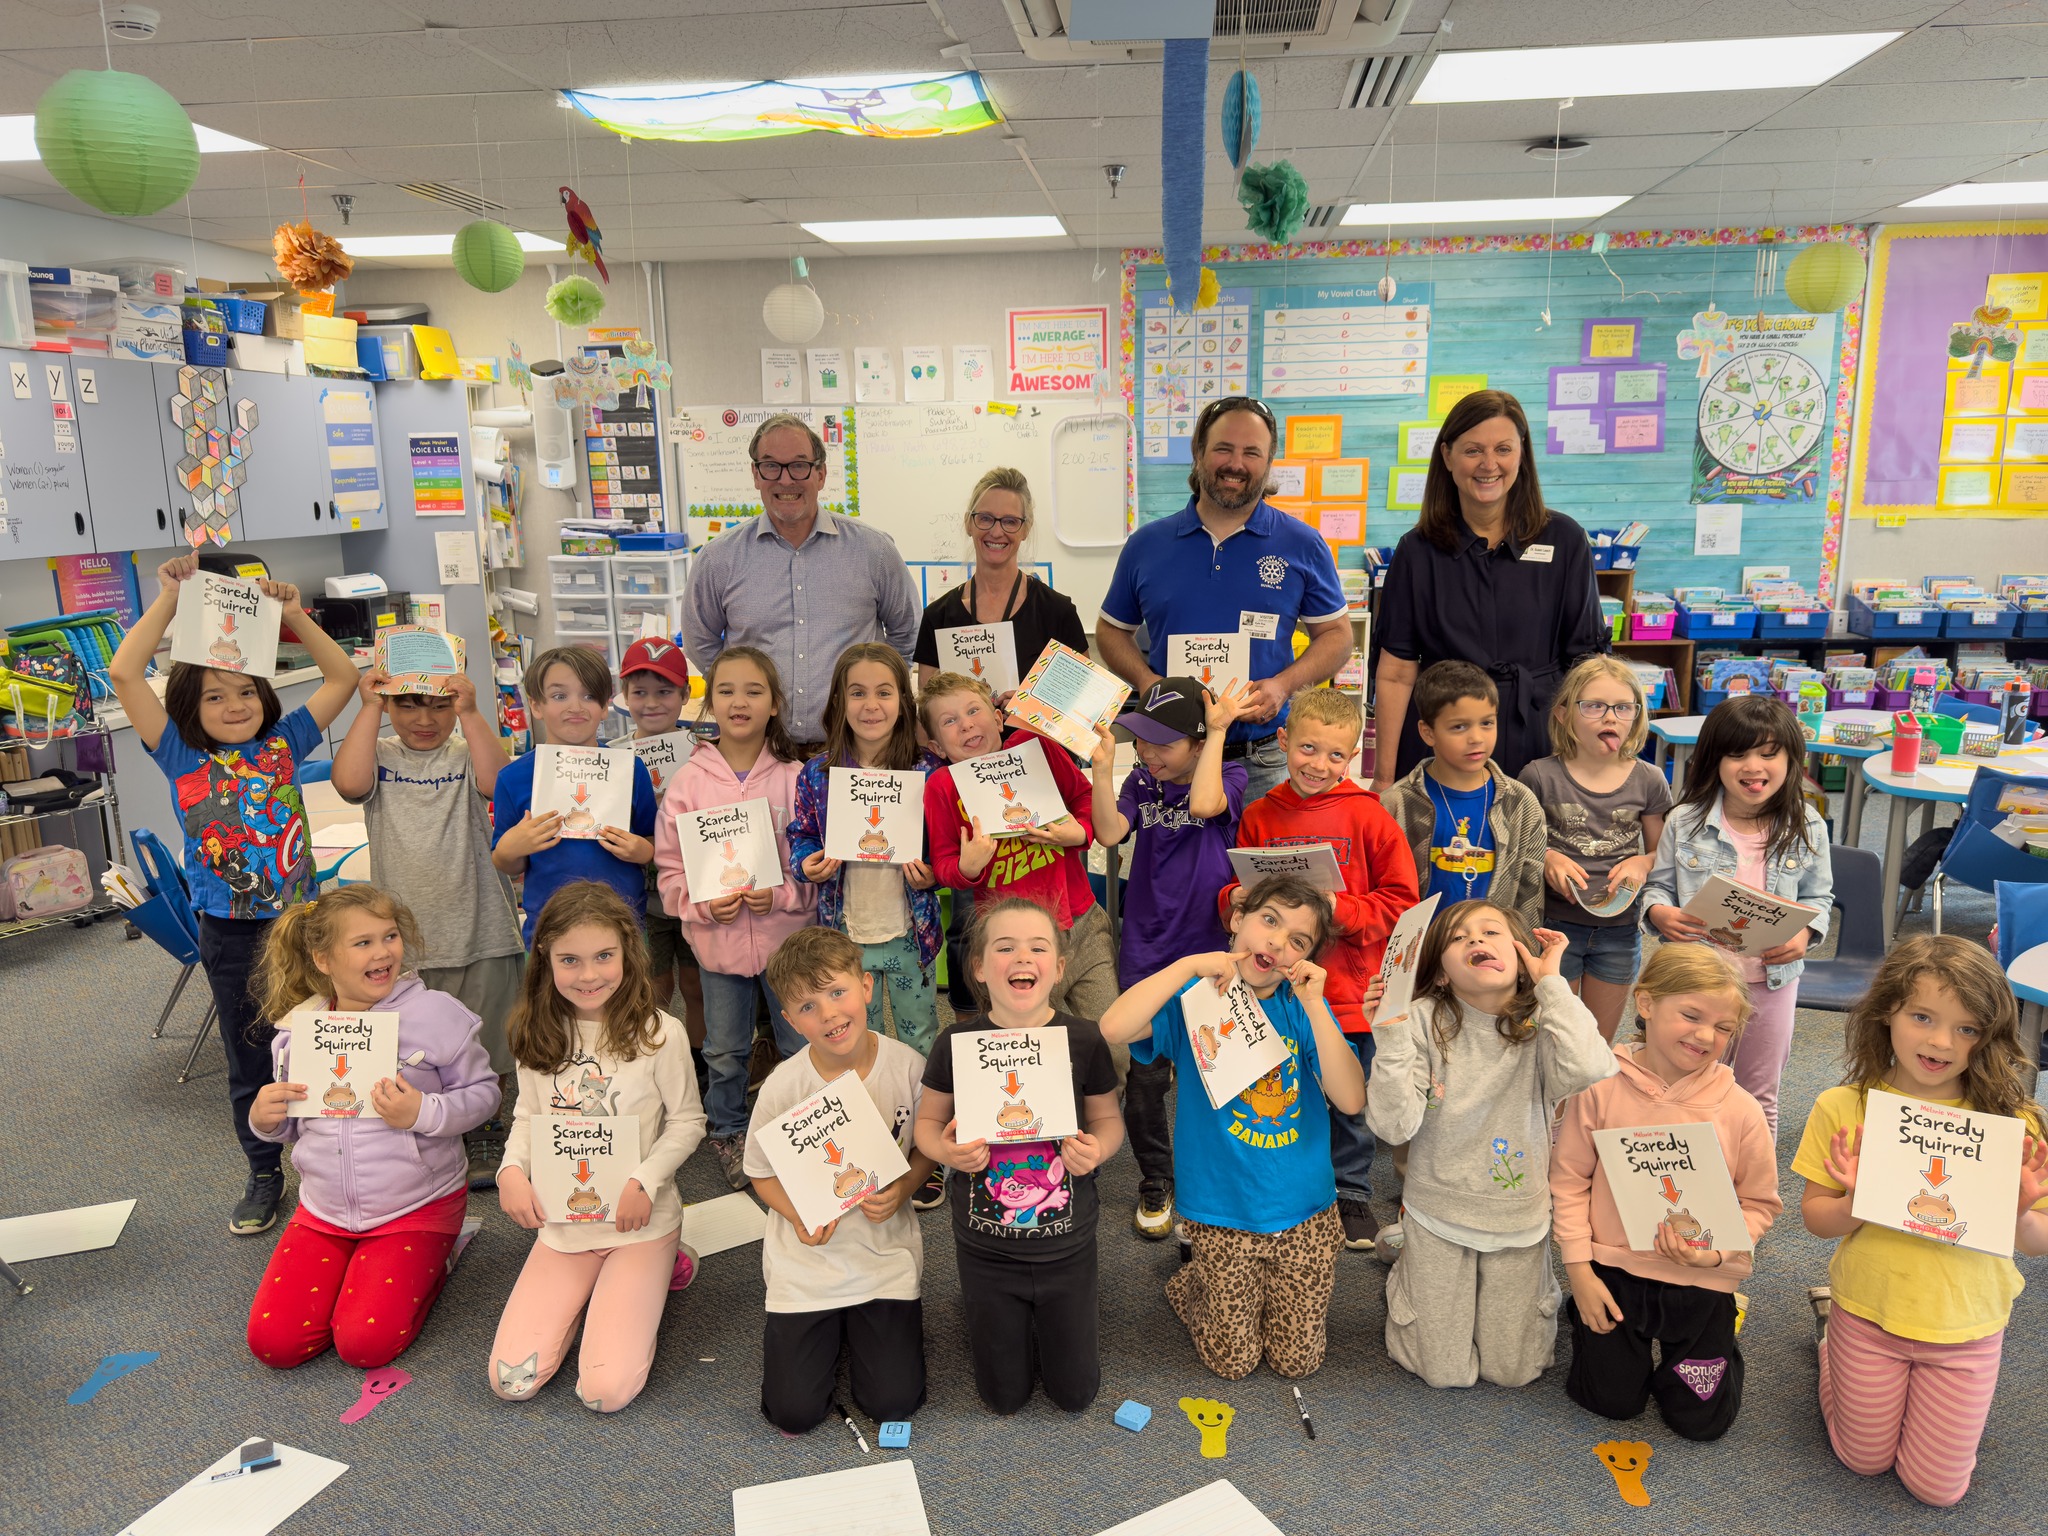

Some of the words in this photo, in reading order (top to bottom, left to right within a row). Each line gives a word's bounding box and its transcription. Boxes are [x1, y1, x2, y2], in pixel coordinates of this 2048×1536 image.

[1318, 291, 1329, 299] My
[1330, 290, 1354, 298] Vowel
[1356, 289, 1377, 297] Chart
[1033, 321, 1052, 330] NOT
[1054, 320, 1073, 329] HERE
[1075, 320, 1086, 329] TO
[1089, 319, 1099, 328] BE
[1774, 317, 1818, 331] CHOICE!
[1032, 330, 1085, 342] AVERAGE
[1341, 329, 1349, 338] e
[1022, 353, 1037, 364] I'M
[1040, 352, 1063, 363] HERE
[1066, 352, 1081, 362] TO
[1083, 352, 1095, 362] BE
[1010, 372, 1096, 392] AWESOM
[57, 441, 75, 449] young
[1753, 479, 1765, 487] BIG
[80, 557, 111, 569] HELLO.
[1256, 555, 1276, 566] ROTARY
[1278, 556, 1289, 568] CLUB
[204, 578, 259, 604] Scaredy
[204, 593, 257, 617] Squirrel
[952, 629, 995, 644] Scaredy
[954, 643, 996, 659] Squirrel
[1185, 639, 1229, 653] Scaredy
[1185, 653, 1229, 666] Squirrel
[634, 739, 674, 756] caredy
[556, 752, 610, 769] Scaredy
[645, 752, 676, 767] uirrel
[971, 753, 1023, 773] Scaredy
[378, 765, 466, 790] Champio
[555, 766, 609, 783] Squirrel
[850, 774, 902, 792] Scaredy
[976, 765, 1028, 784] Squirrel
[850, 789, 902, 805] Squirrel
[697, 808, 749, 829] Scaredy
[700, 824, 751, 843] Squirrel
[1250, 856, 1308, 866] Scaredy
[1254, 864, 1311, 874] Squirrel
[1721, 898, 1780, 926] Squirrel
[1727, 890, 1787, 918] Scaredy
[1227, 987, 1258, 1050] Squirrel
[1236, 978, 1268, 1042] Scaredy
[314, 1019, 372, 1037] Scaredy
[314, 1036, 371, 1055] Squirrel
[977, 1034, 1041, 1052] Scaredy
[979, 1052, 1043, 1072] Squirrel
[782, 1096, 843, 1139] Scaredy
[1900, 1105, 1985, 1143] Scaredy
[1947, 1111, 1962, 1119] Watt
[553, 1123, 612, 1142] Scaredy
[791, 1109, 852, 1154] Squirrel
[1227, 1120, 1300, 1149] BANANA
[554, 1141, 613, 1160] Squirrel
[1620, 1133, 1689, 1155] Scaredy
[1899, 1126, 1982, 1162] Squirrel
[1627, 1155, 1696, 1177] Squirrel
[968, 1216, 1023, 1239] DON'T
[1026, 1218, 1073, 1239] CARE
[1910, 1222, 1957, 1239] SCHOLASTIC
[1679, 1360, 1726, 1377] SPOTLIGHT
[1687, 1372, 1721, 1384] DANCE
[1695, 1383, 1715, 1394] CUP
